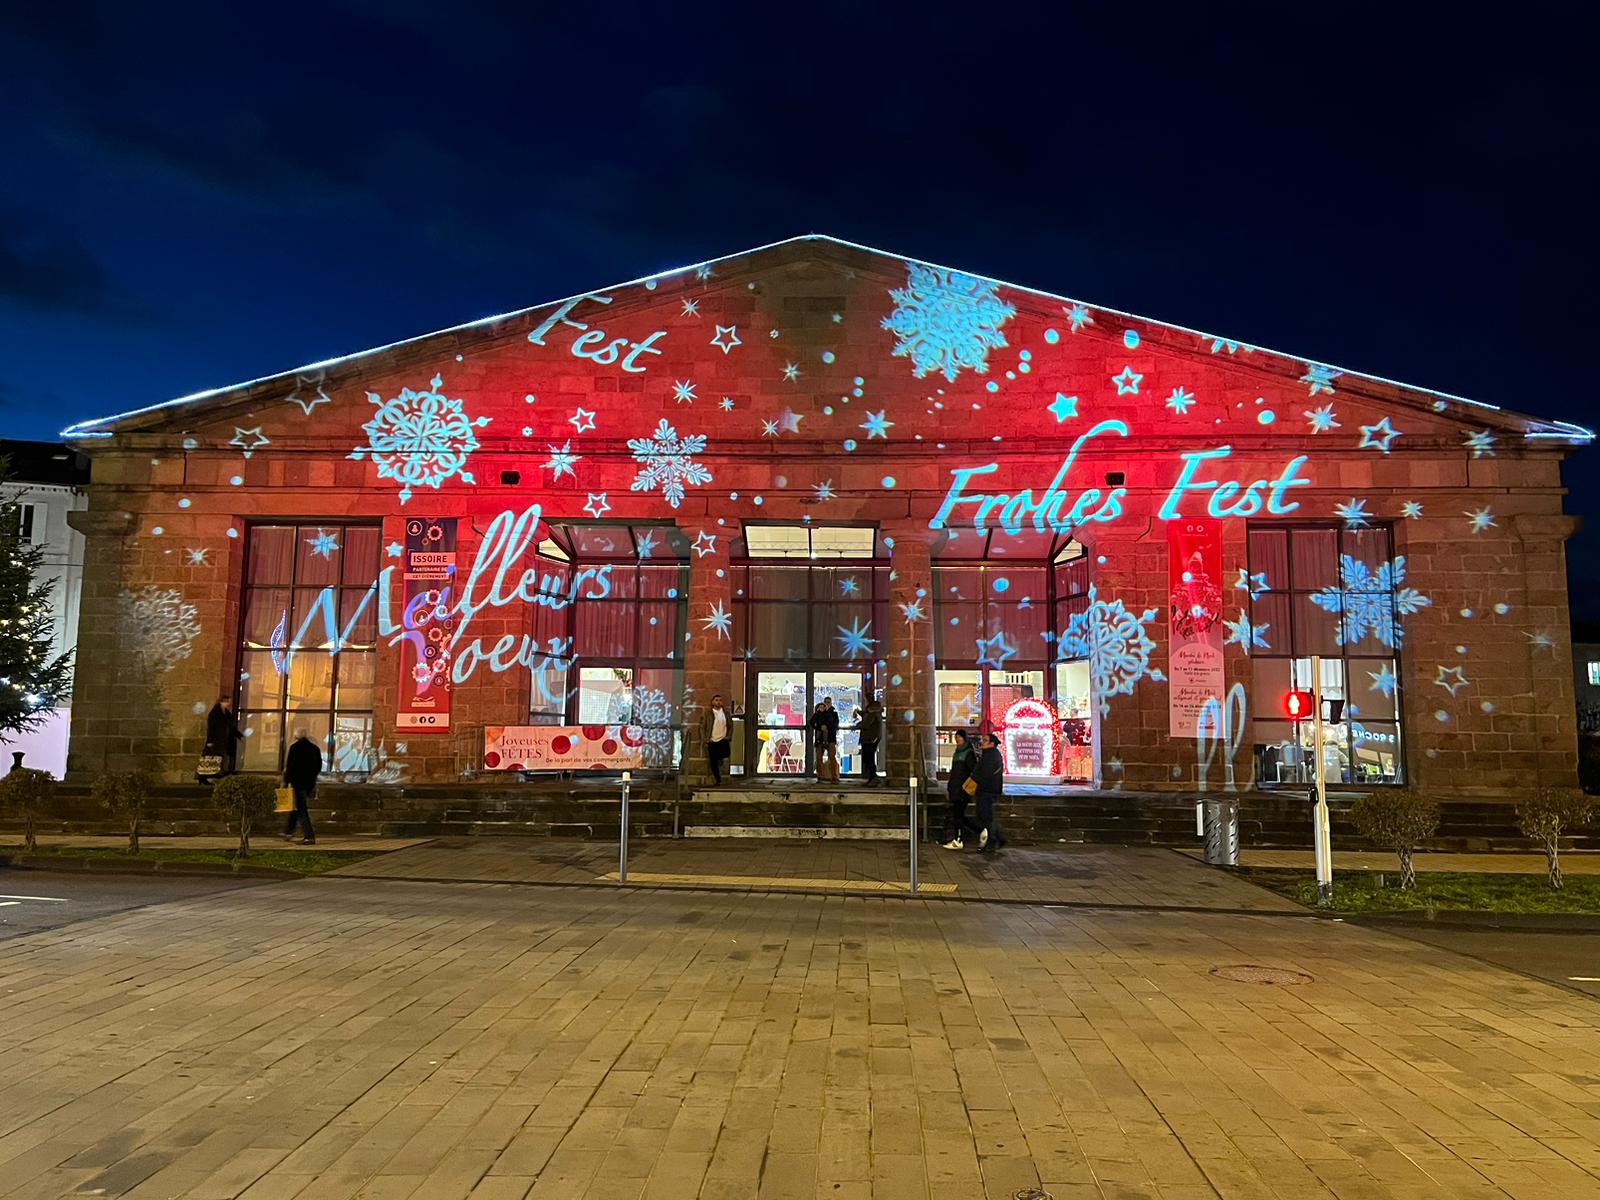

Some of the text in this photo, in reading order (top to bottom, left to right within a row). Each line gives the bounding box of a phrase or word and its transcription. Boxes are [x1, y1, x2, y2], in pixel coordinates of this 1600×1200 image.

[527, 293, 668, 373] Fest
[928, 419, 1312, 536] Frohes Fest
[413, 555, 448, 563] ISSOIRE
[500, 735, 549, 748] Joyeuses
